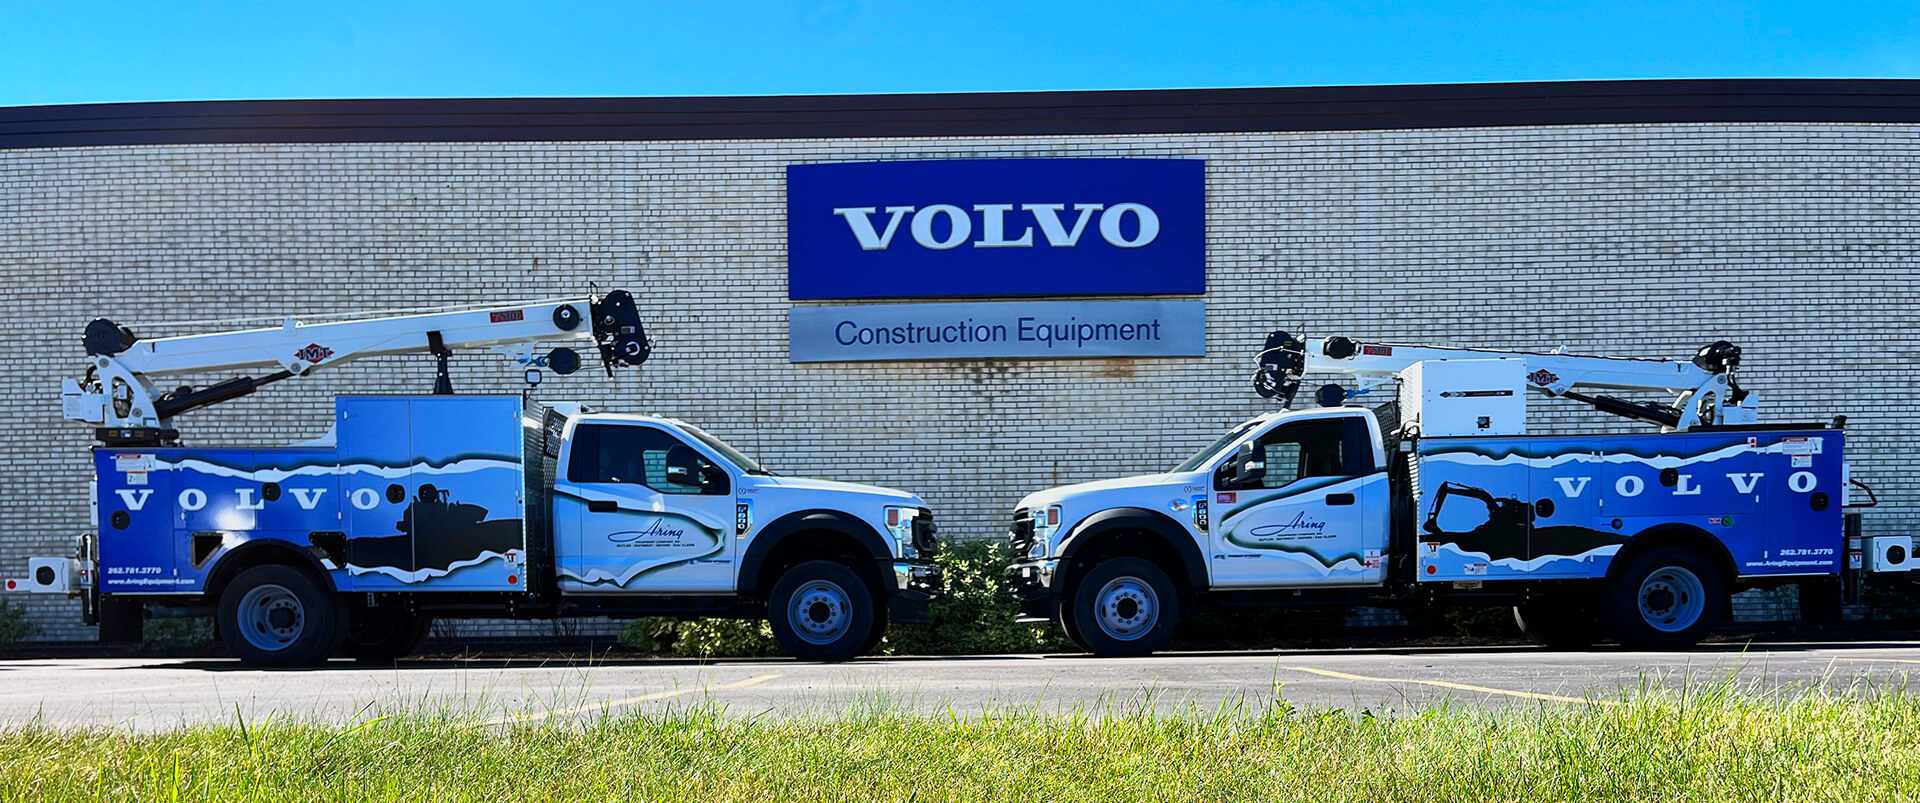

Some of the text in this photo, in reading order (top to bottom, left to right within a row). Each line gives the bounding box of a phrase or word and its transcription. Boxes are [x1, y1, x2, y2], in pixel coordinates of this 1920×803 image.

[833, 202, 1160, 250] VOLVO
[835, 317, 1161, 348] Construction Equipment
[298, 346, 331, 361] IMT
[1529, 372, 1557, 383] IMT
[1554, 471, 1818, 498] VOLVO
[115, 488, 380, 511] VOLVO
[607, 517, 684, 543] Aring
[1251, 510, 1326, 537] Aring
[1780, 548, 1834, 556] 262.781.3770
[107, 566, 162, 575] 262.781.3770
